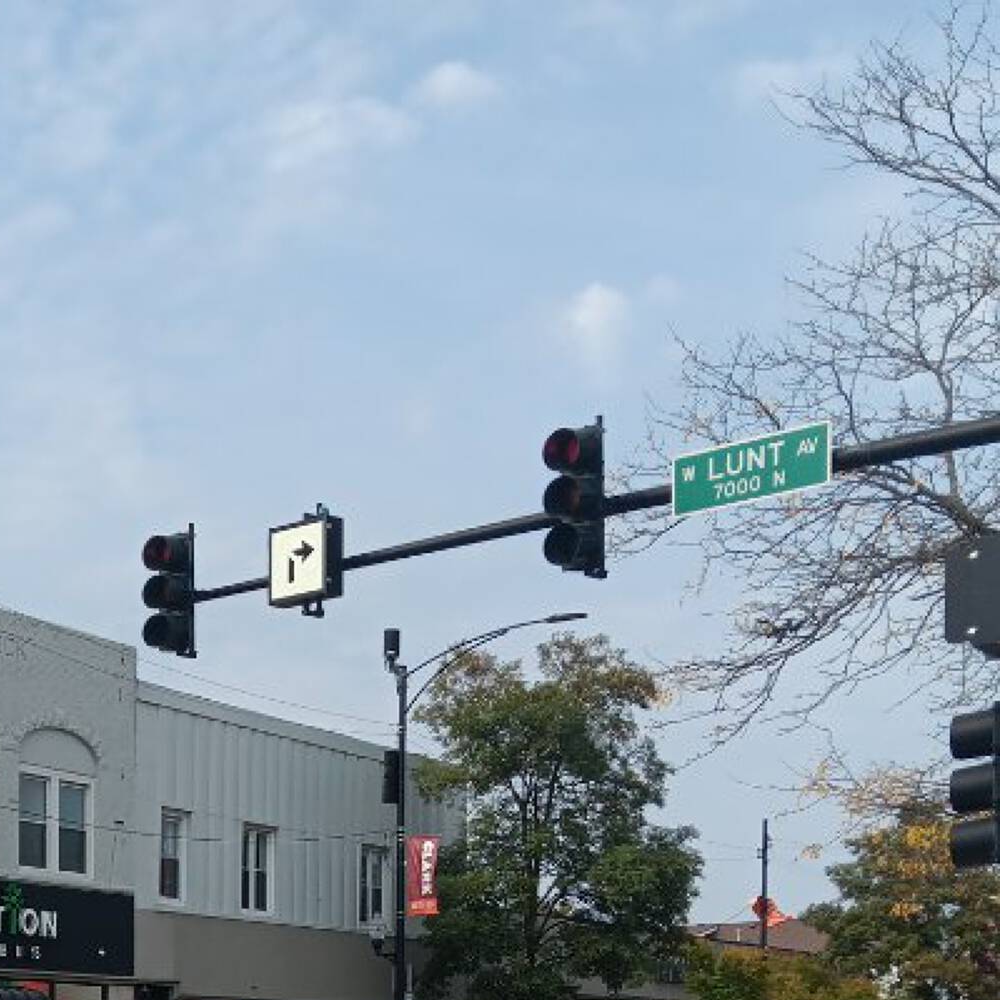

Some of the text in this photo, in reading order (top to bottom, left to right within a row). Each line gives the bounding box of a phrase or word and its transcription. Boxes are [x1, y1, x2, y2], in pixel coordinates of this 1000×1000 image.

[682, 437, 818, 482] W LUNT AV
[714, 470, 785, 499] 7000 N
